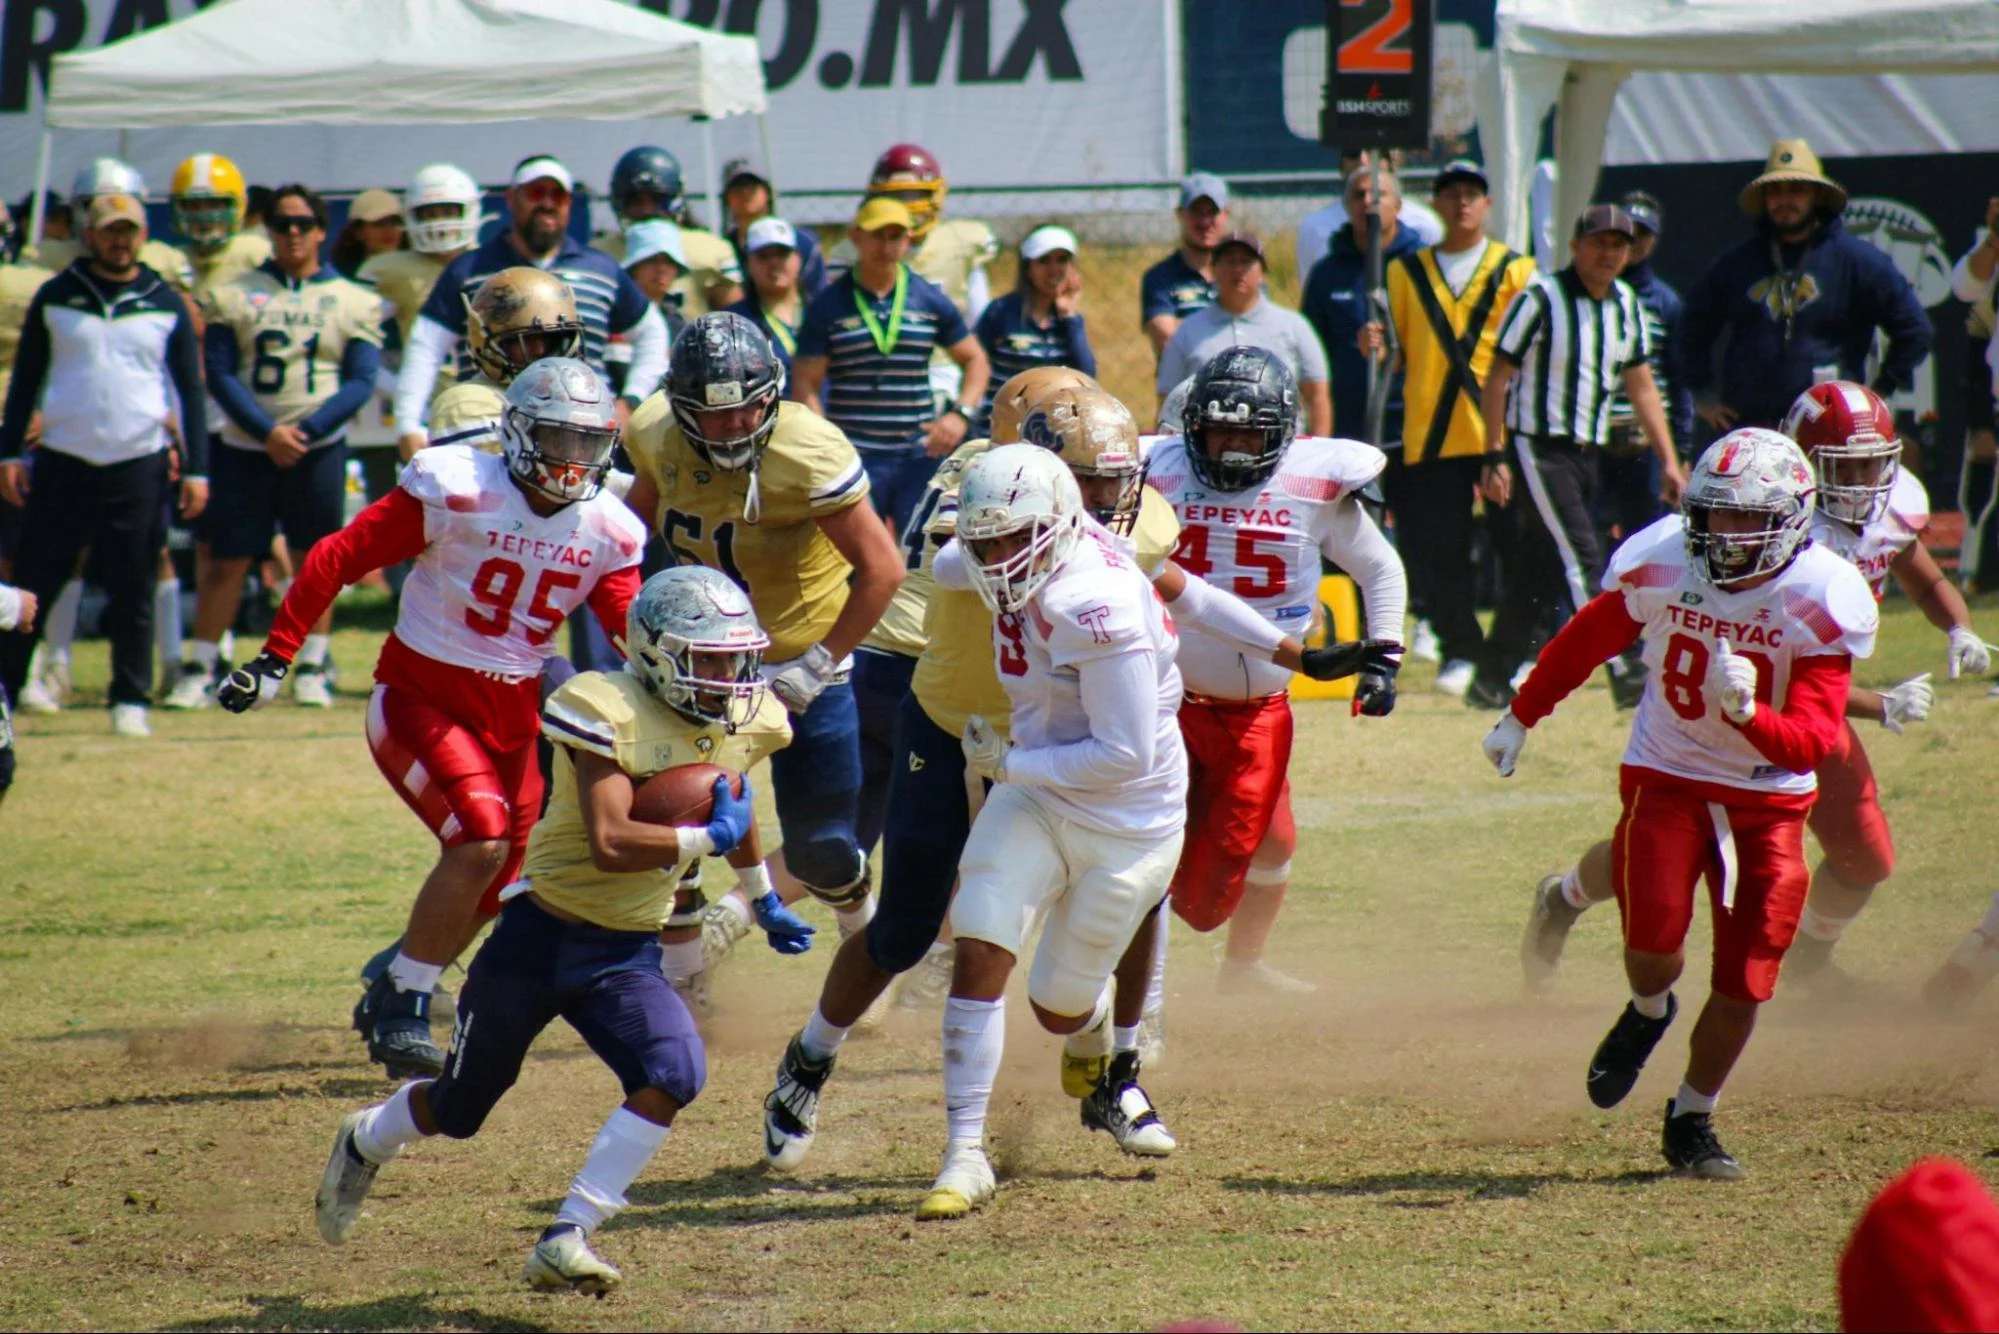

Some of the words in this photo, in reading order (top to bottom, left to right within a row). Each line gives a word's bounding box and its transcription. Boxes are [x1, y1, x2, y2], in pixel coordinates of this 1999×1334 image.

[634, 0, 1084, 93] O.MX
[1338, 0, 1413, 73] 2
[253, 329, 320, 395] 61
[1168, 523, 1286, 599] 45
[464, 556, 582, 647] 95
[1077, 604, 1111, 645] T
[1666, 604, 1784, 649] TEPEYAC
